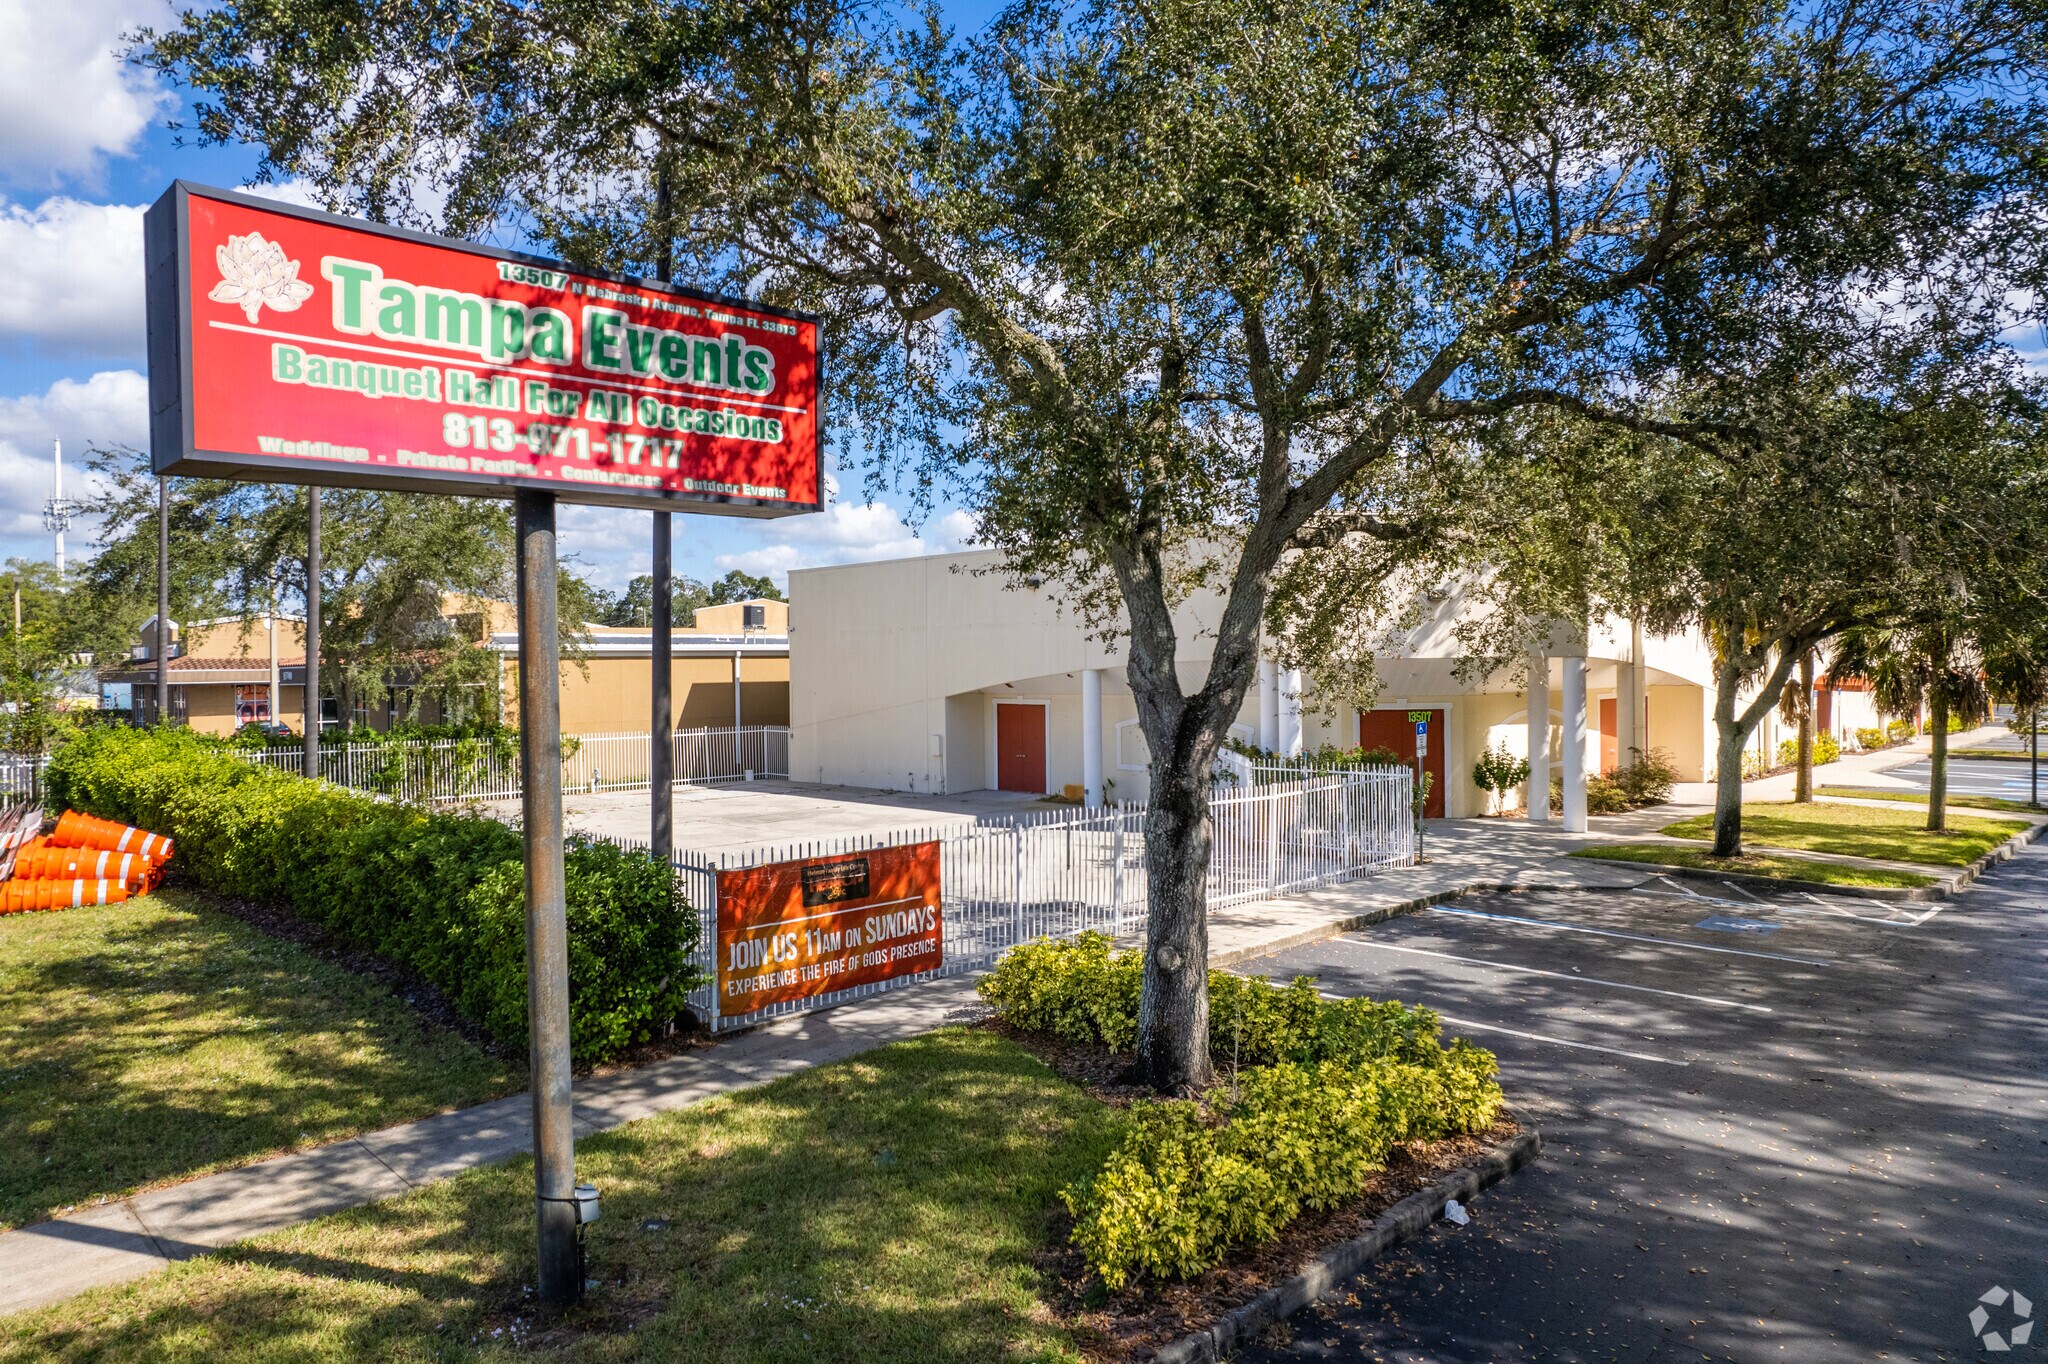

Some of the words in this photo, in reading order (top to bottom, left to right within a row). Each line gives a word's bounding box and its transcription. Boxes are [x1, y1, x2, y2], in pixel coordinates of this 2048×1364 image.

[322, 257, 572, 364] Tampa
[582, 305, 775, 396] Events
[496, 261, 569, 292] 13507
[571, 282, 583, 294] N
[586, 284, 649, 308] Nebraska
[652, 298, 702, 319] Avenue,
[704, 308, 744, 326] Tampa
[746, 317, 760, 330] FL
[762, 320, 797, 336] 33613
[272, 343, 442, 402] Banquet
[445, 368, 520, 412] Hall
[525, 379, 582, 418] For
[585, 389, 633, 425] All
[637, 396, 783, 444] Occasions
[257, 435, 369, 462] Weddings
[397, 449, 469, 471] Private
[470, 456, 538, 476] Parties
[561, 465, 662, 488] Conferences
[683, 478, 739, 495] Outdoor
[742, 483, 787, 499] Events
[443, 412, 684, 468] 813-971-1717
[1408, 711, 1432, 722] 13507
[727, 937, 768, 971] JOIN
[772, 932, 798, 963] US
[804, 928, 841, 957] 11AM
[845, 927, 862, 948] ON
[865, 905, 936, 944] SUNDAYS
[727, 968, 798, 997] EXPERIENCE
[800, 964, 820, 982] THE
[823, 958, 845, 977] FIRE
[848, 955, 860, 971] OF
[862, 948, 888, 967] GODS
[890, 938, 936, 962] PRESENCE
